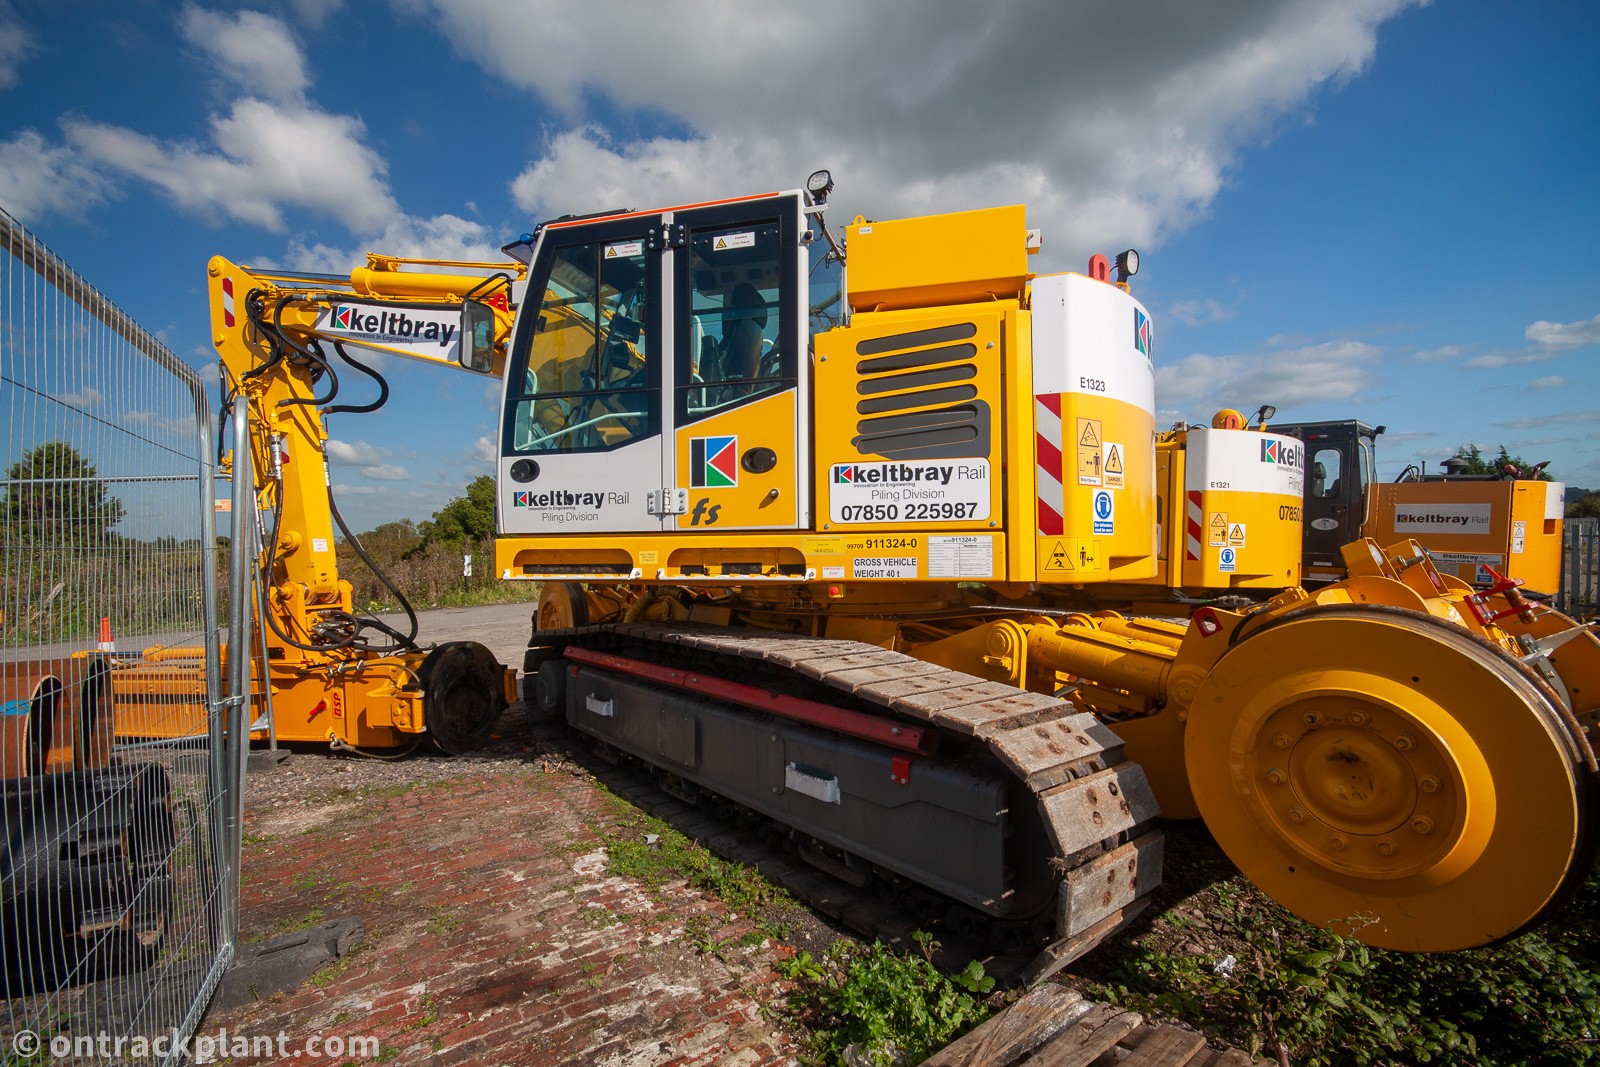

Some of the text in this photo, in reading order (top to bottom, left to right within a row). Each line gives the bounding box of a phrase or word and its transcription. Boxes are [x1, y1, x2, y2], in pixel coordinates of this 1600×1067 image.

[350, 308, 456, 347] keltbray
[348, 332, 376, 340] Innovation
[382, 334, 414, 344] Engineering
[1080, 376, 1106, 392] E1323
[854, 464, 986, 485] keltbray Rail
[528, 490, 630, 509] keltbray Rail
[871, 488, 945, 502] Piling Division
[542, 512, 598, 523] Piling Division
[842, 502, 978, 521] 07850 225987
[1409, 514, 1488, 526] keltbray Rail
[866, 538, 917, 549] 911324-0
[854, 558, 916, 567] GROSS VEHICLE
[854, 569, 900, 578] WEIGHT 40 t
[333, 692, 342, 716] BSP
